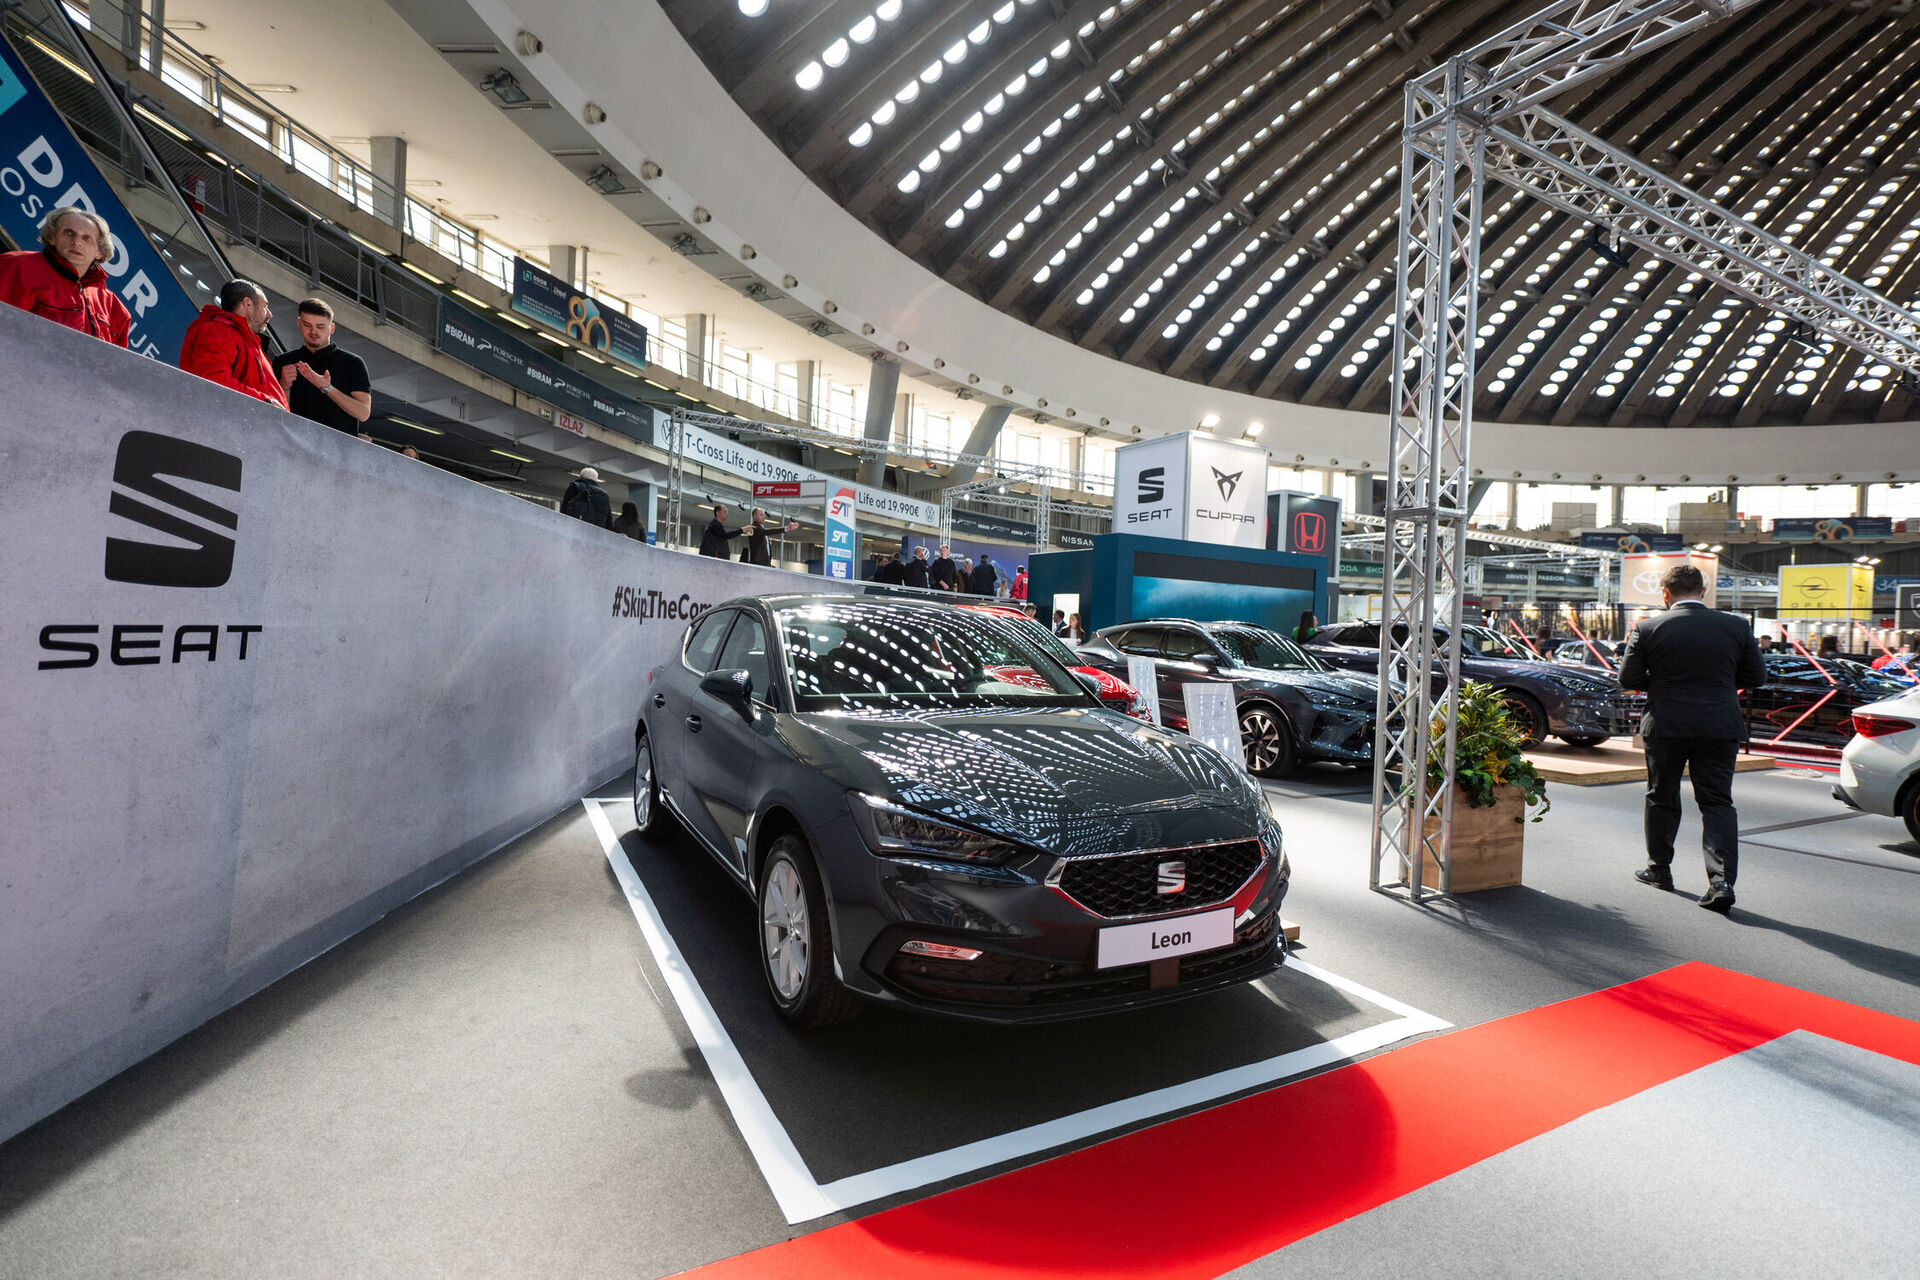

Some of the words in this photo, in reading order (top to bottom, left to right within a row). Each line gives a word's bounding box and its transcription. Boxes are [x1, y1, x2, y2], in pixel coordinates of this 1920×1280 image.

[445, 323, 475, 347] #BIRAM
[527, 367, 552, 387] #BIRAM
[593, 400, 615, 416] #BIRAM
[559, 414, 584, 435] IZLAZ
[685, 432, 724, 462] T-Cross
[726, 448, 745, 469] Life
[746, 459, 759, 474] od
[761, 462, 800, 482] 19.990€
[858, 491, 874, 507] Life
[875, 497, 886, 510] od
[888, 500, 920, 518] 19.990€
[1127, 508, 1173, 524] SEAT
[1196, 508, 1255, 525] CUPRA
[1061, 535, 1094, 547] NISSAN
[38, 624, 263, 671] SEAT
[1151, 930, 1193, 950] Leon
